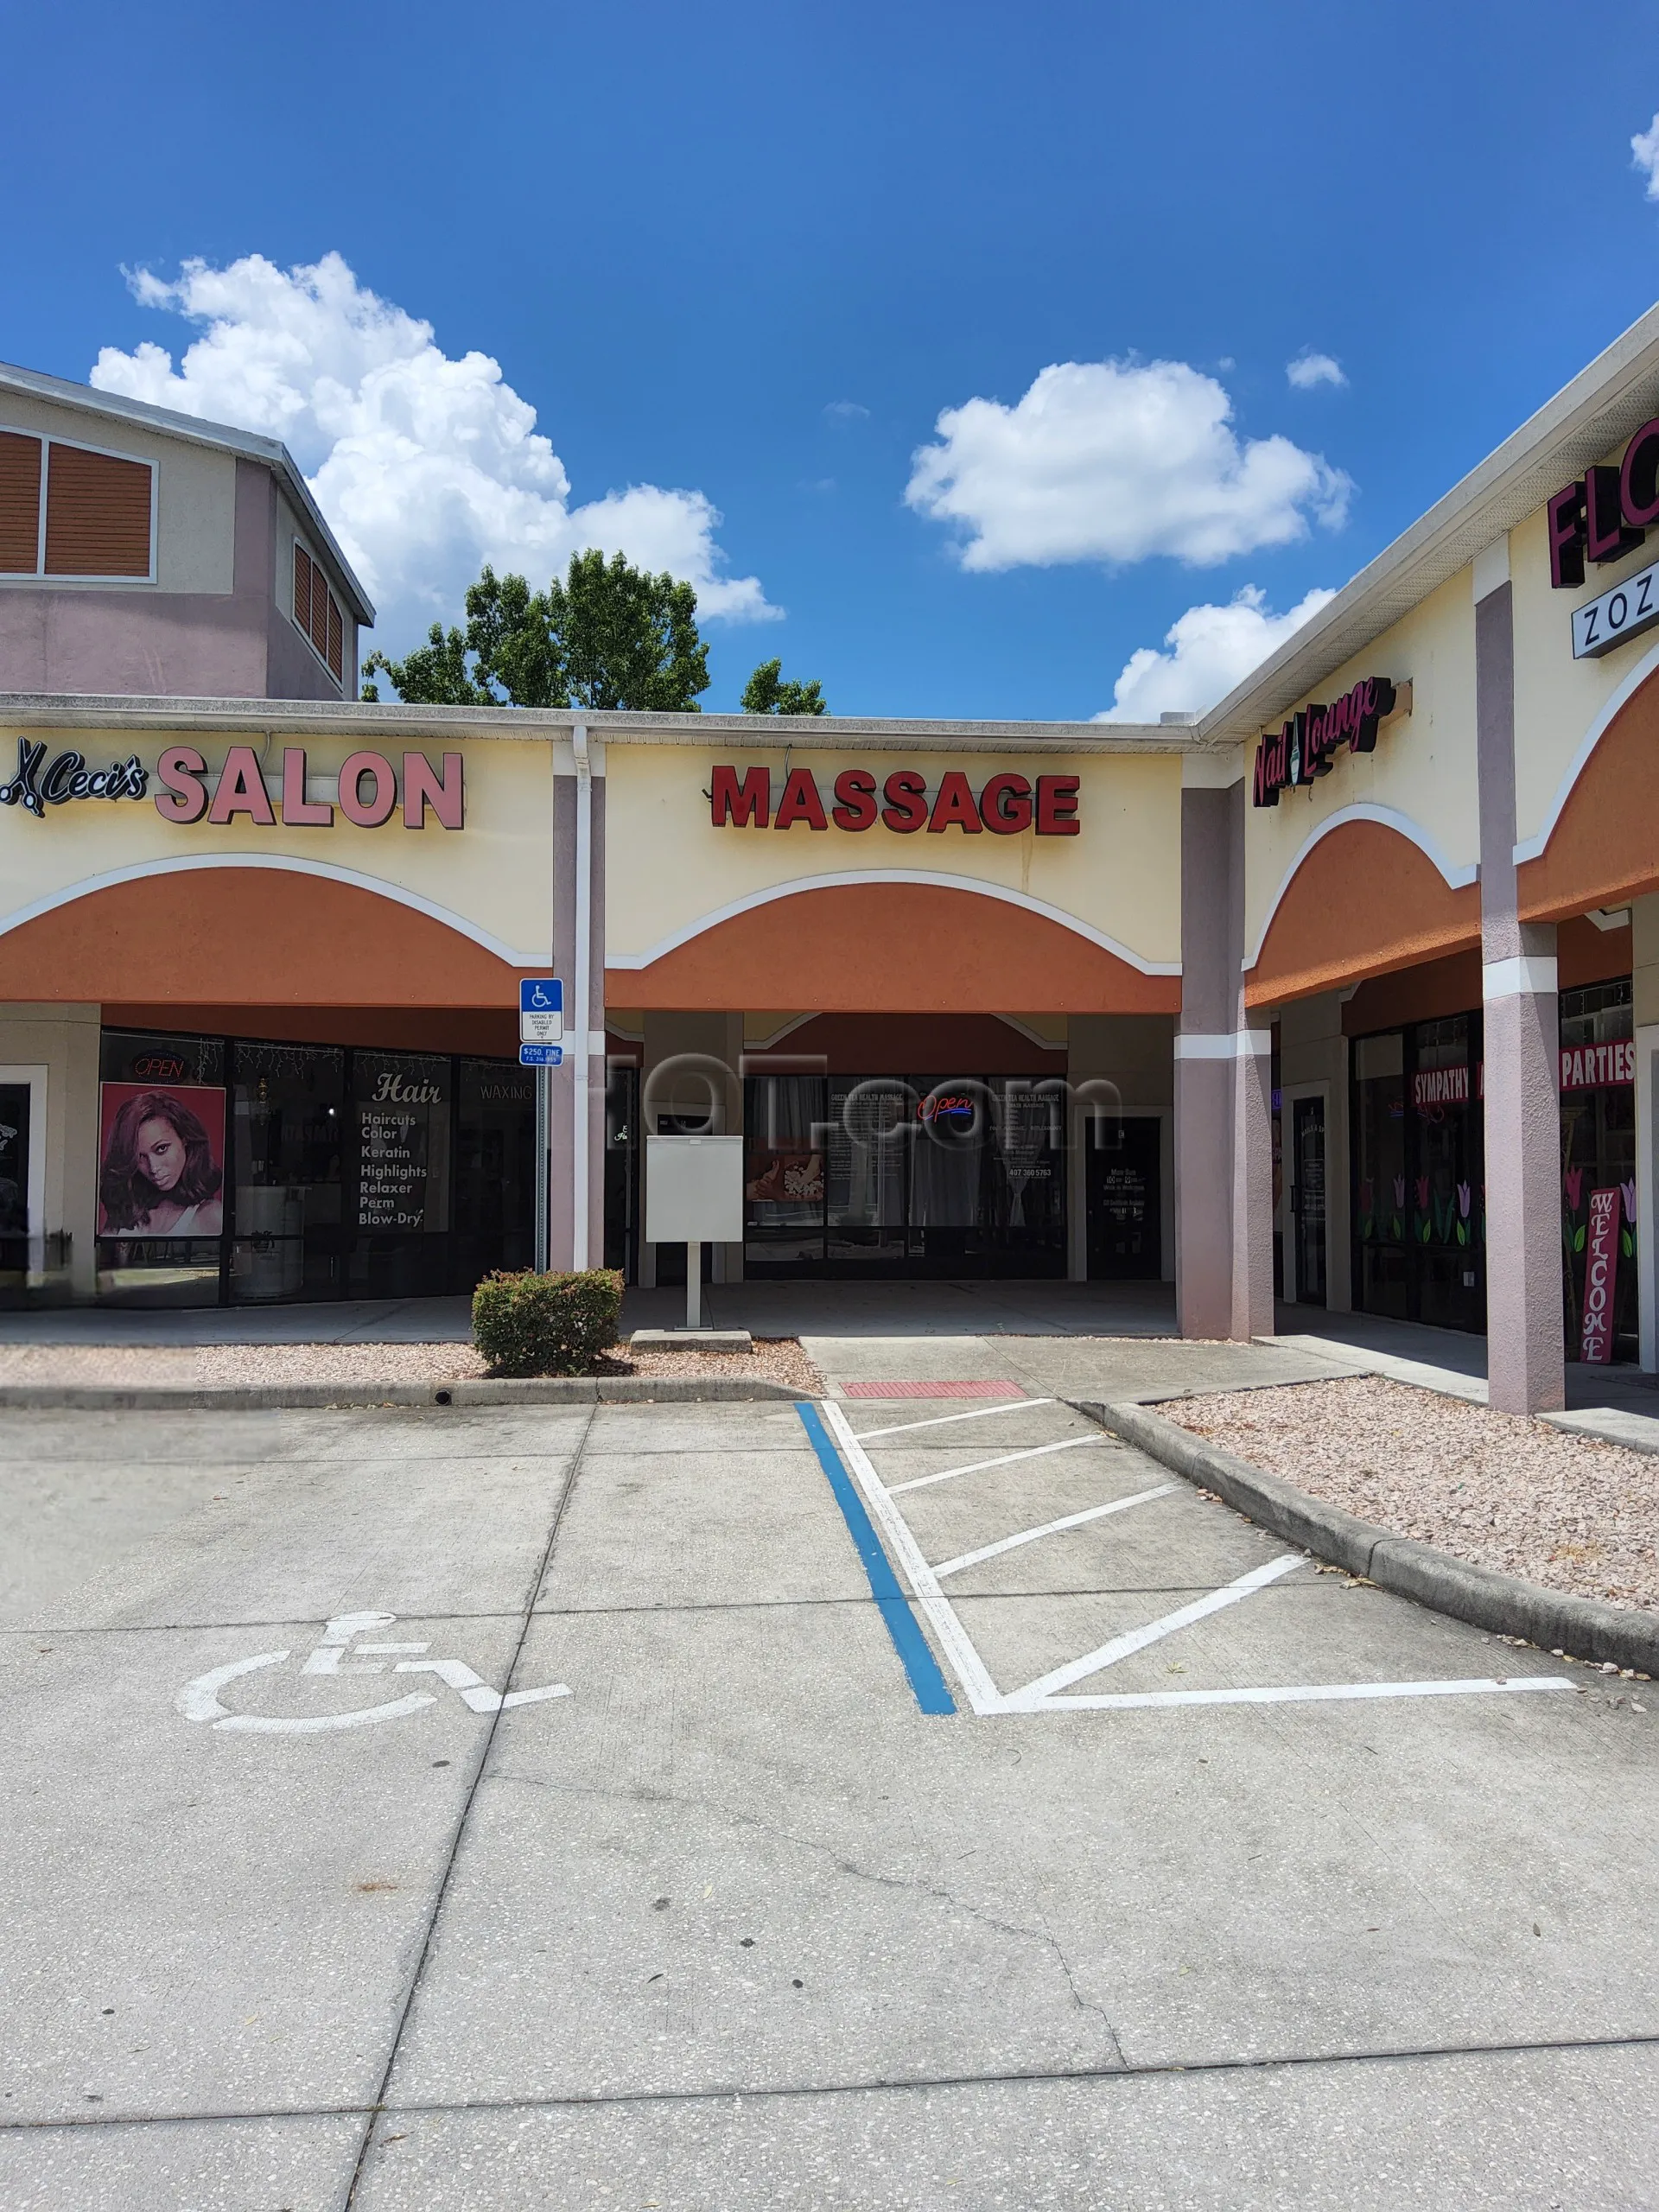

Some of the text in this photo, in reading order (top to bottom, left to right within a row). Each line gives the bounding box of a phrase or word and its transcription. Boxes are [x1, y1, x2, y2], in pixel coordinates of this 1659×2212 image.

[1584, 574, 1653, 646] ZOZ
[1254, 677, 1387, 807] Nail Lounge
[40, 746, 464, 830] Ceci's SALON
[711, 765, 1080, 836] MASSAGE
[545, 1048, 560, 1057] FINE
[135, 1058, 185, 1077] OPEN
[1562, 1042, 1635, 1087] PARTIES
[372, 1072, 442, 1104] Hair
[480, 1085, 532, 1099] WAXING
[1414, 1066, 1469, 1104] SYMPATHY
[918, 1095, 974, 1122] Open
[361, 1112, 416, 1125] Haircuts
[361, 1127, 397, 1140] Color
[360, 1145, 410, 1159] Keratin
[360, 1165, 427, 1180] Highlights
[359, 1181, 413, 1194] Relaxer
[359, 1197, 395, 1209] Perm
[359, 1211, 424, 1228] Blow-Dry
[1583, 1191, 1614, 1362] WELCOME
